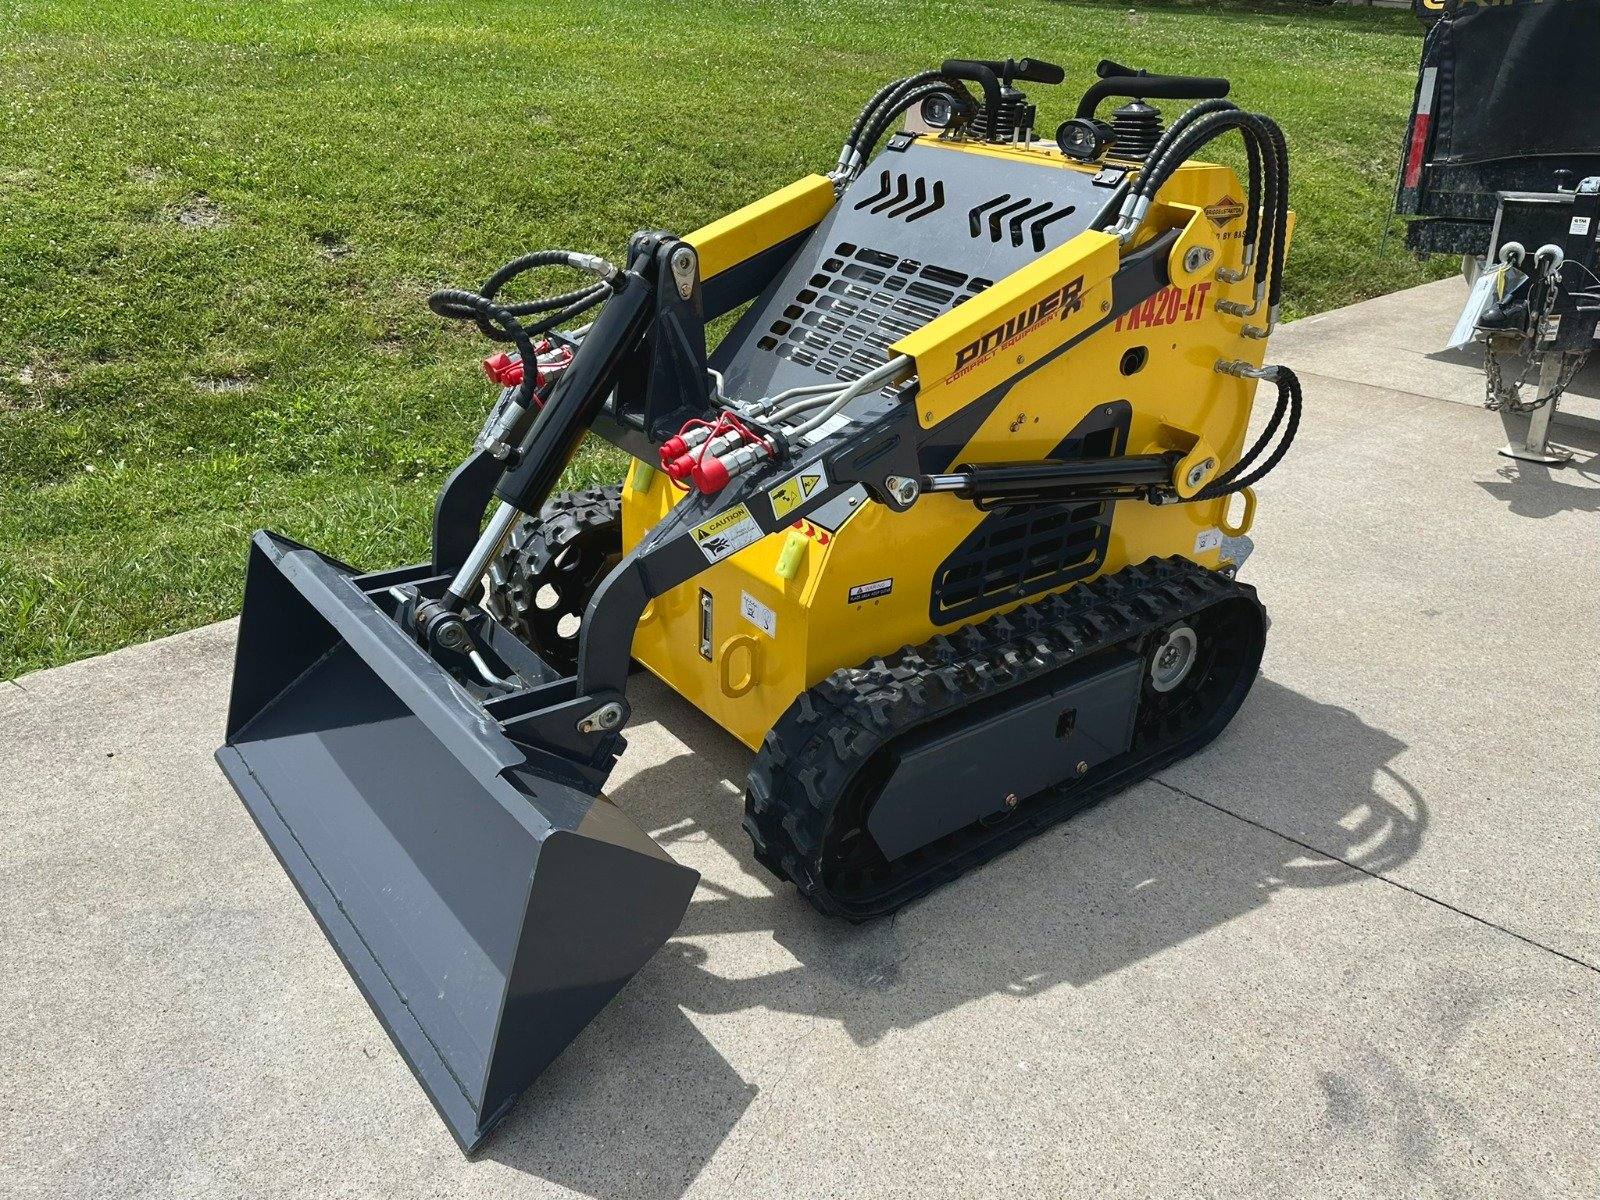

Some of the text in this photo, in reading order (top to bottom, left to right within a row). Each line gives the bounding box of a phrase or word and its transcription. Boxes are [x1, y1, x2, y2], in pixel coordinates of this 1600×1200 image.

[1222, 232, 1232, 240] BY
[955, 274, 1085, 373] POWER
[945, 311, 1060, 386] COMPACT EQUIPMENT
[709, 508, 745, 531] CAUTION
